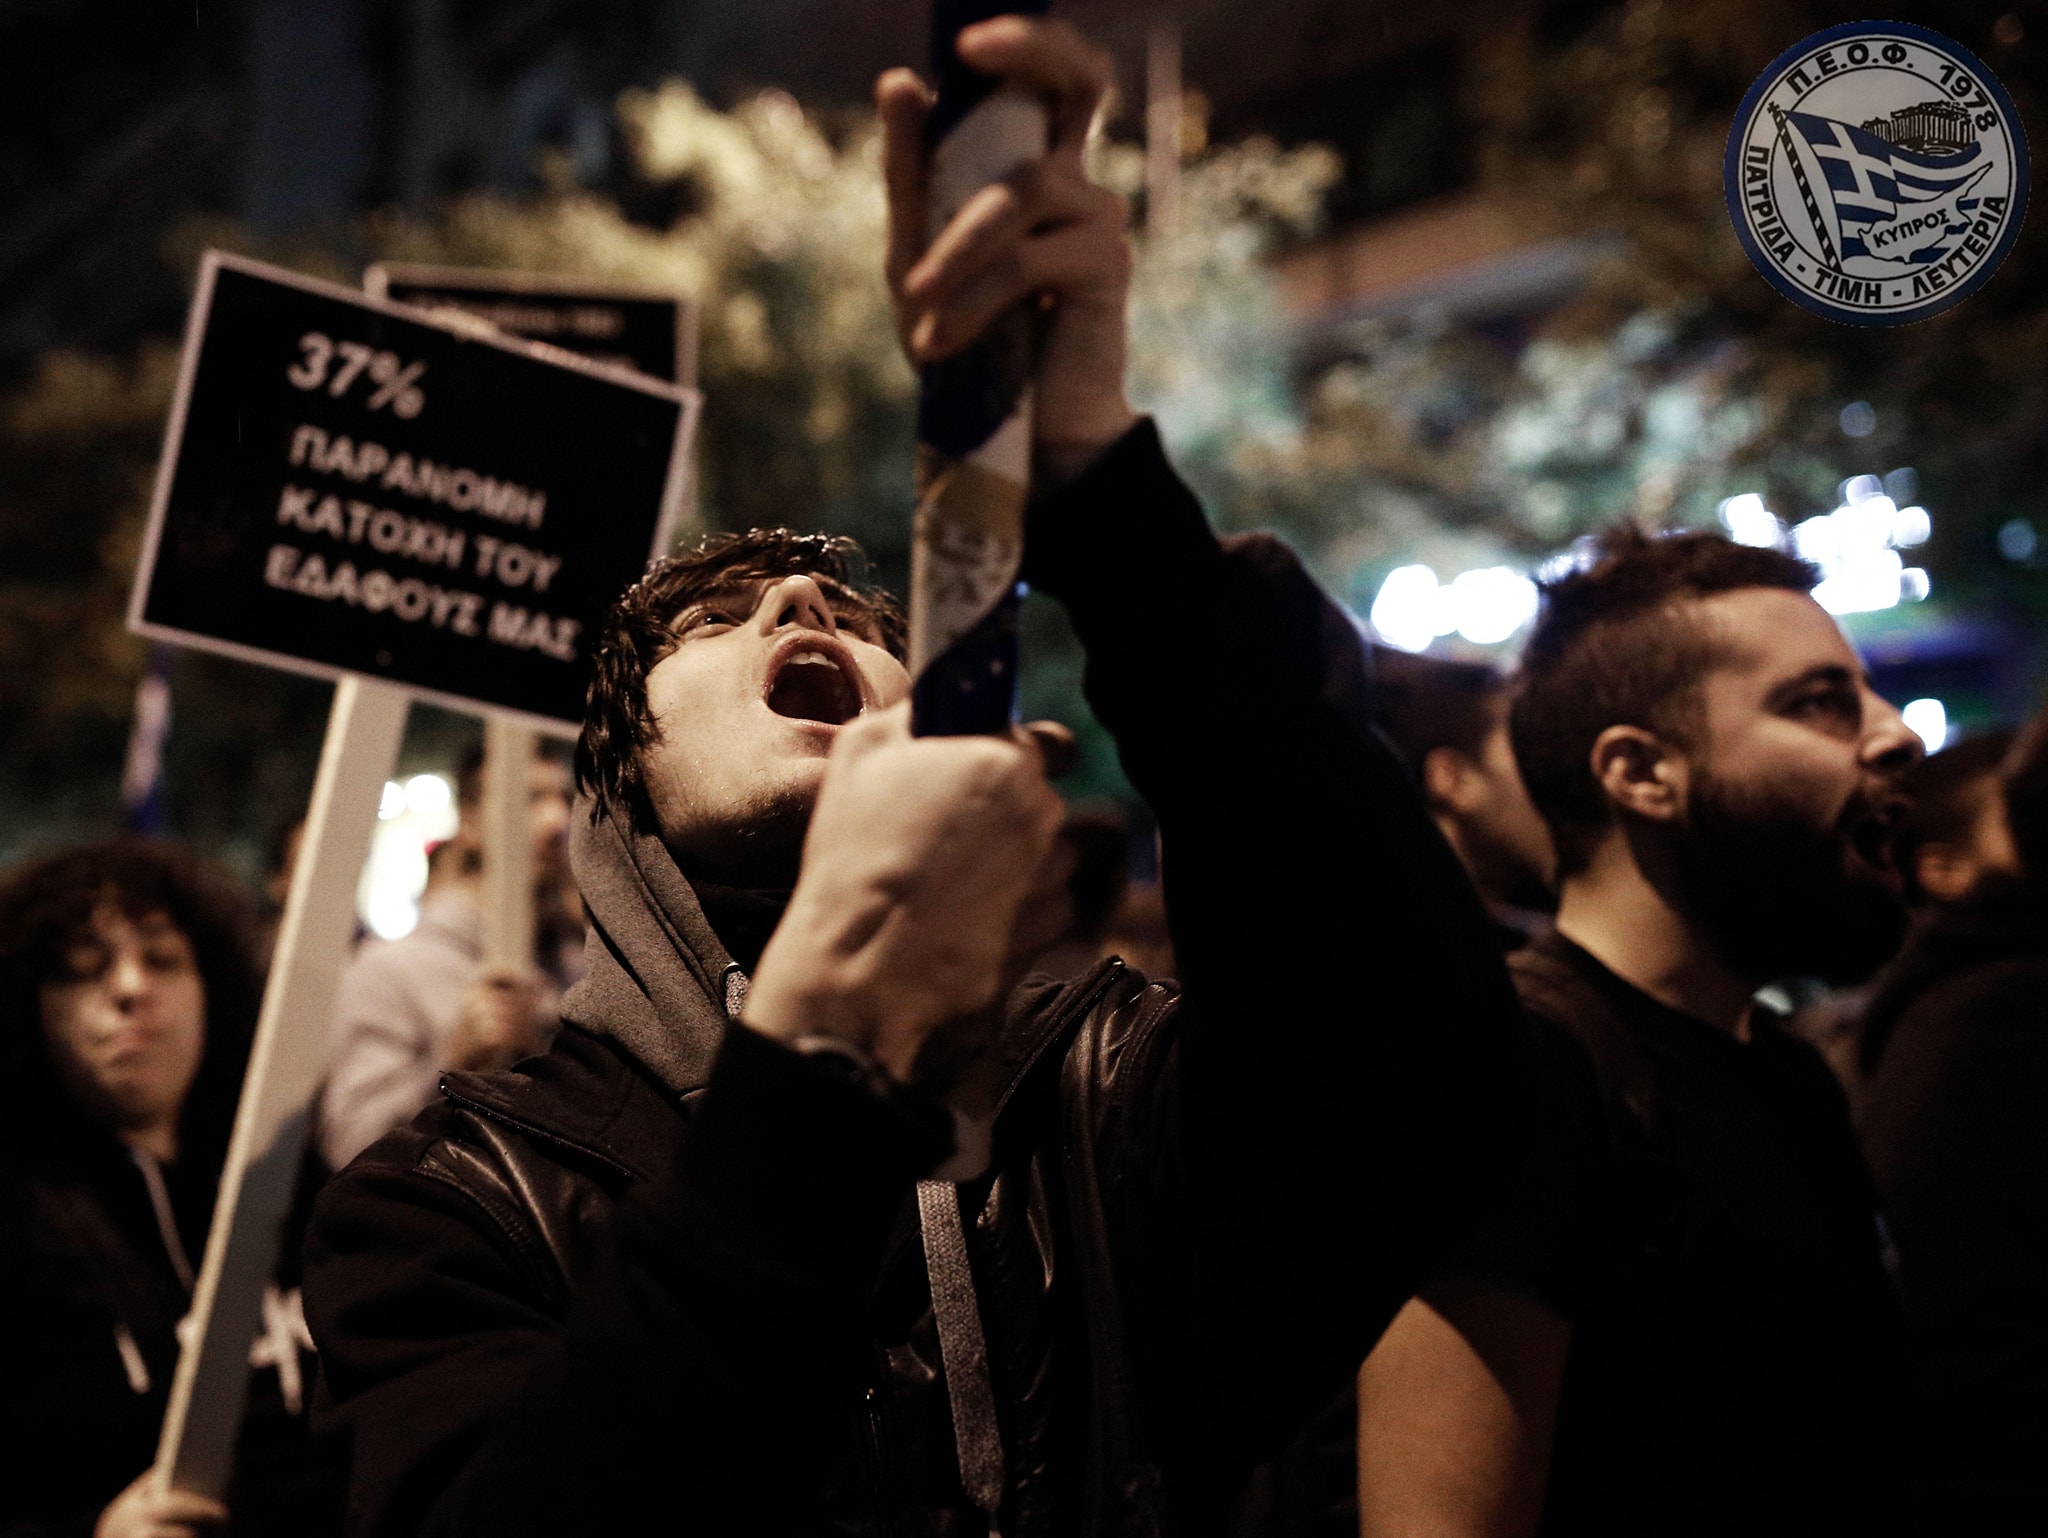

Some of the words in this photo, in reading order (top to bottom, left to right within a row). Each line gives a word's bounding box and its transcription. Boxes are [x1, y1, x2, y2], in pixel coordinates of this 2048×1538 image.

[287, 332, 427, 419] 37%
[289, 424, 546, 529] ΠΑΡΑΝΟΜΗ
[277, 484, 466, 571] ΚΑΤΟΧΗ
[474, 535, 562, 592] ΤΟΥ
[263, 543, 484, 638] ΕΔΑΦΟΥΣ
[488, 606, 582, 662] ΜΑΣ
